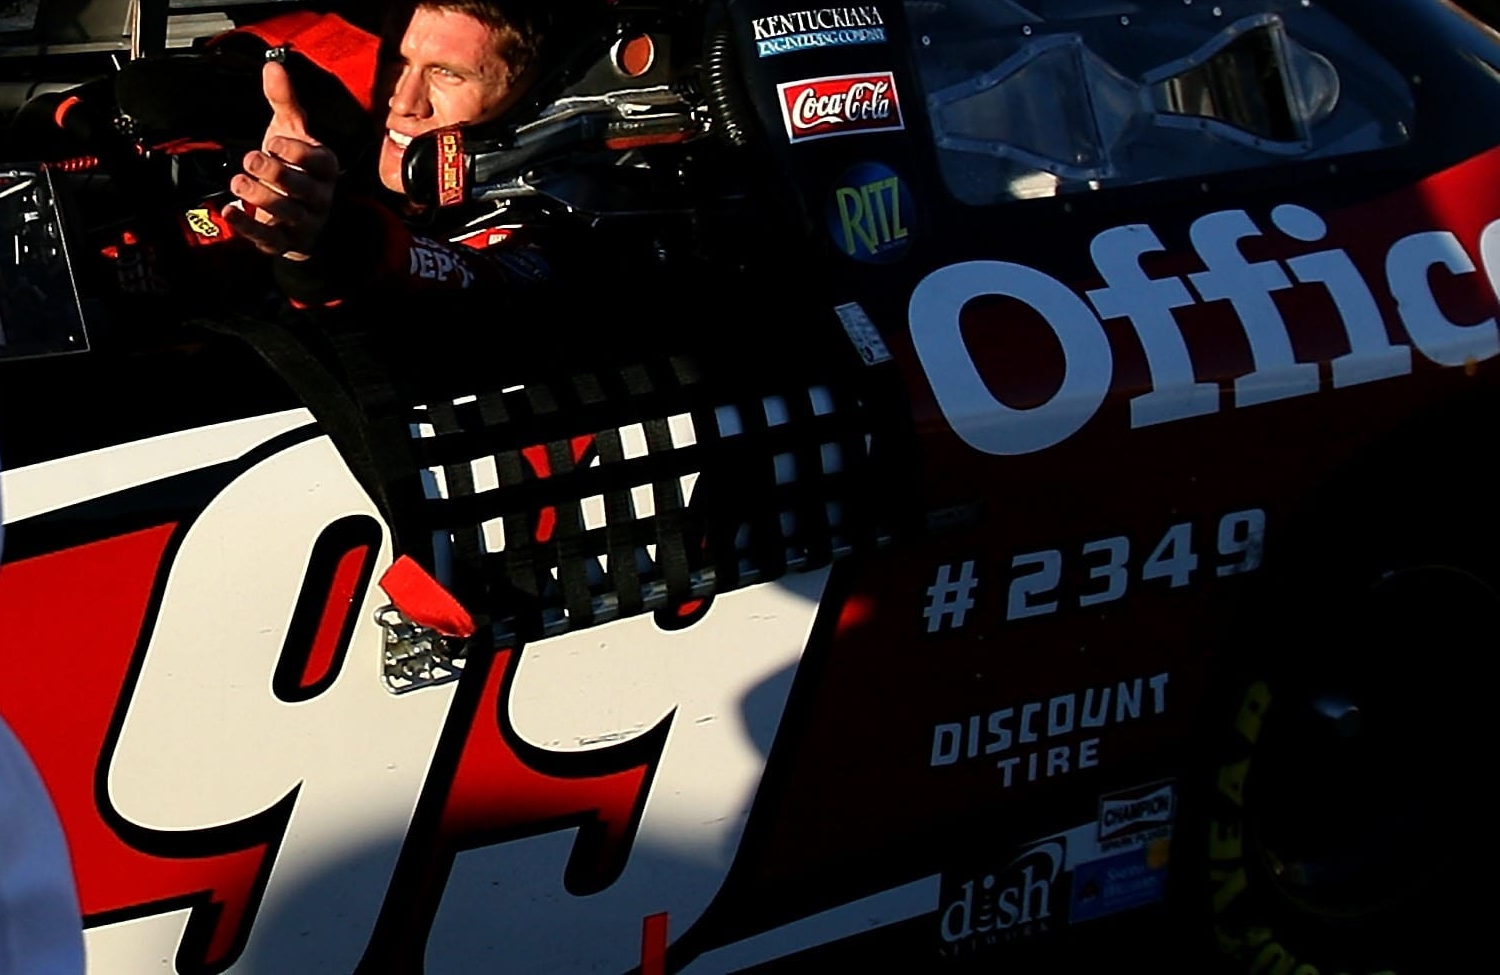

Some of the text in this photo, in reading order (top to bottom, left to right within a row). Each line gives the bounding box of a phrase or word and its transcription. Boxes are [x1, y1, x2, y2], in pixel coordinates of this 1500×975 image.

[752, 6, 884, 41] KENTUCKIANA
[792, 80, 890, 129] Coca-Cola
[443, 135, 457, 190] BUTLER
[836, 176, 909, 255] RITZ
[908, 204, 1500, 455] Offic
[930, 672, 1169, 767] DISCOUNT
[997, 737, 1100, 788] TIRE
[1104, 794, 1170, 826] CHAMPION
[940, 863, 1052, 943] dish
